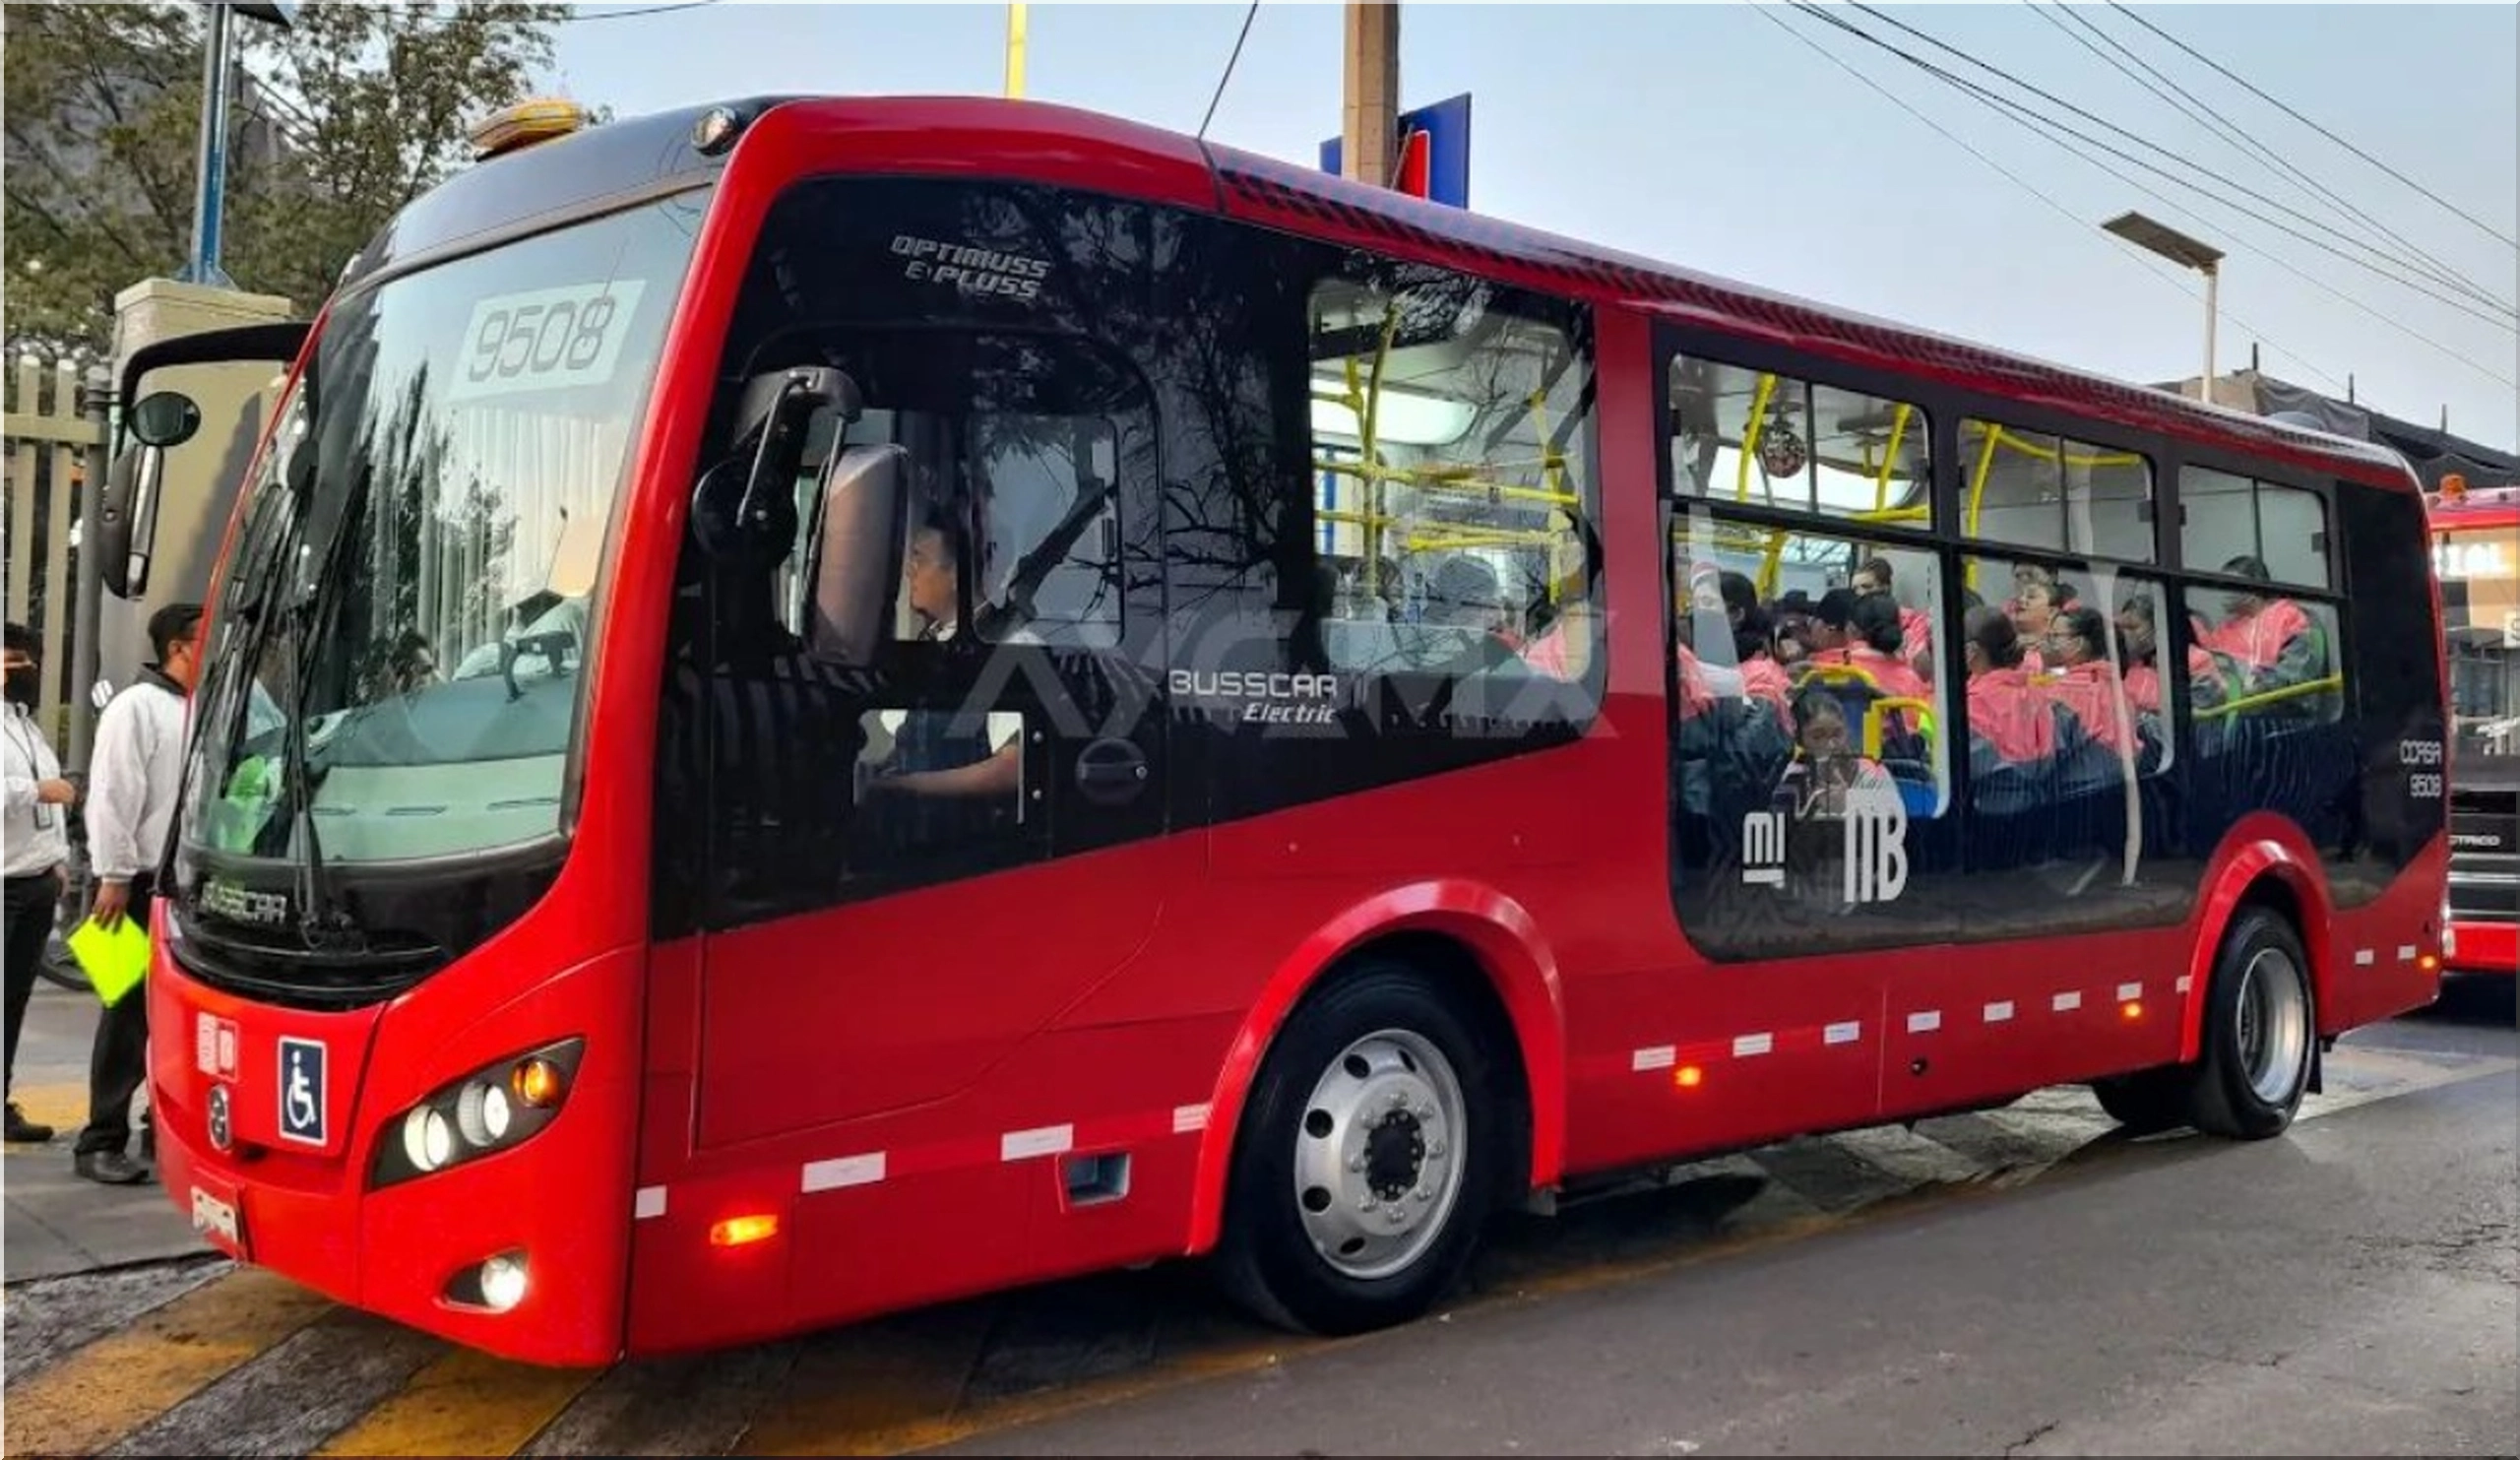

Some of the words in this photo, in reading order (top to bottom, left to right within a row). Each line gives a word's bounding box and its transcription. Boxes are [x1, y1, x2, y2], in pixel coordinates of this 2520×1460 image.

[890, 235, 1050, 279] OPTIMUSS
[932, 265, 1041, 298] PLUSS
[469, 295, 615, 382] 9508
[1168, 669, 1337, 698] BUSSCAR
[1242, 702, 1336, 724] Electric
